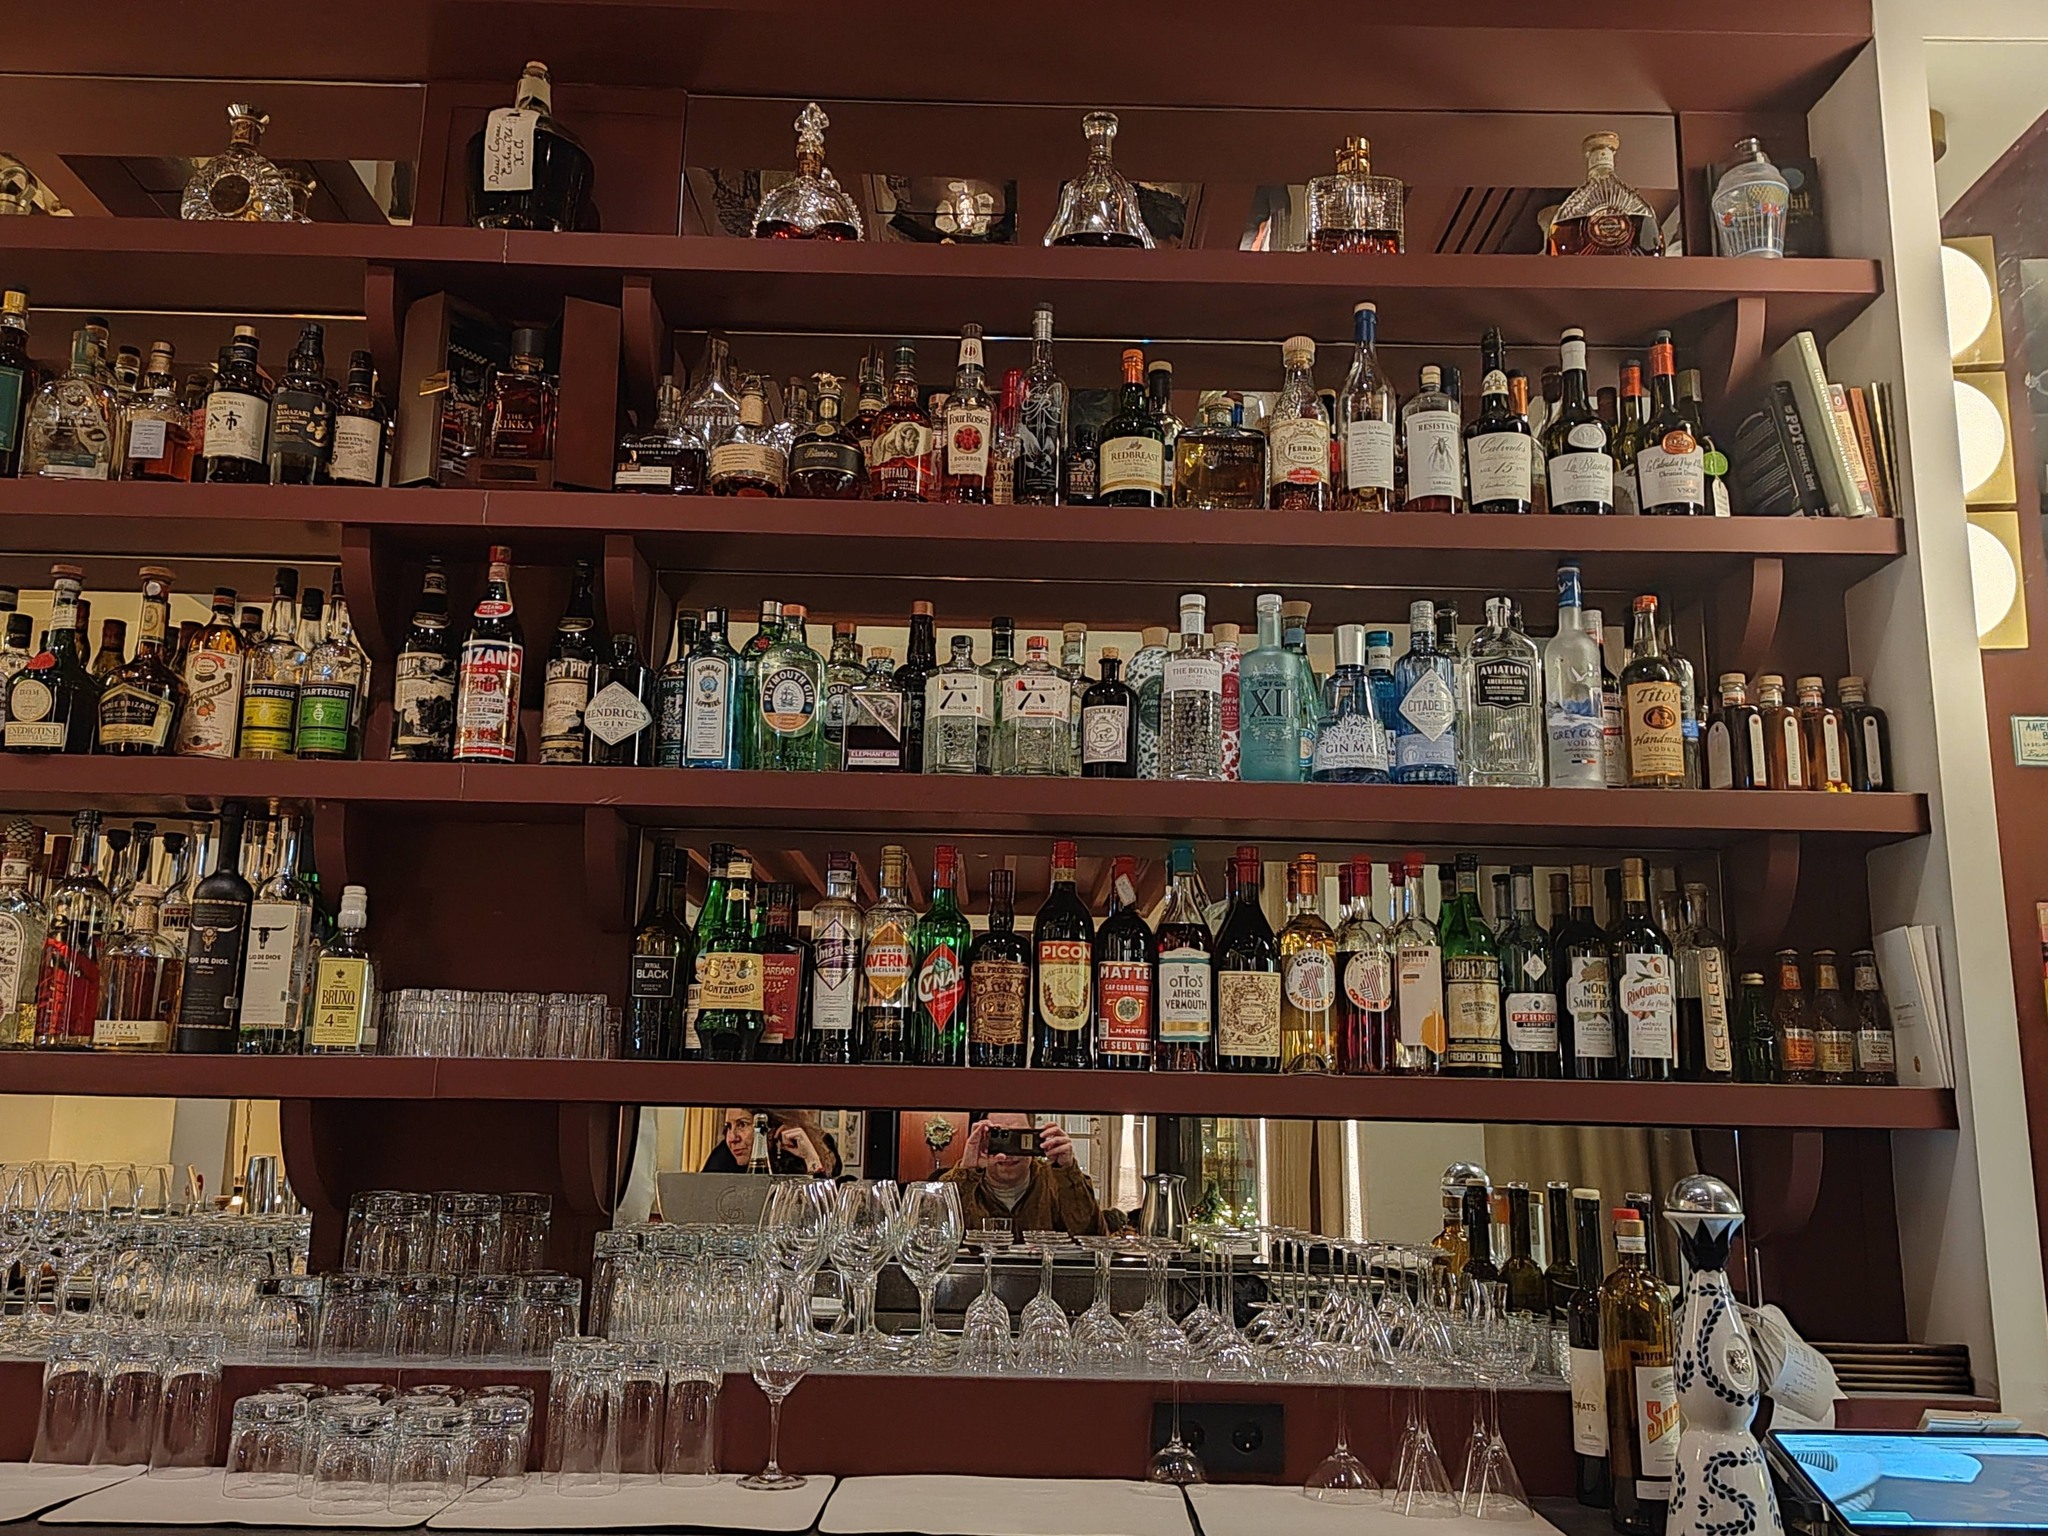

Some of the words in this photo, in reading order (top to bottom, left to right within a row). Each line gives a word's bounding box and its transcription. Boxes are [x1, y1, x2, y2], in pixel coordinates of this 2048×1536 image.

[1288, 443, 1322, 456] FERRAND
[1478, 436, 1526, 454] Calvados
[1110, 451, 1160, 463] REDBREAST
[880, 466, 909, 480] BUFFALO
[461, 647, 519, 668] INZANO
[1172, 667, 1189, 676] THE
[1479, 665, 1530, 678] AVIATION
[763, 670, 808, 701] PLYMOUTH
[802, 681, 815, 703] GIN
[1635, 686, 1678, 704] Tito's
[587, 707, 648, 721] HENDRICK'S
[603, 720, 624, 728] GIN
[1552, 730, 1577, 744] GREY
[1579, 727, 1603, 742] GOO
[1633, 732, 1682, 747] Handma
[1325, 740, 1351, 754] GIN
[1646, 747, 1677, 756] VODKA
[850, 753, 883, 762] ELEPHANT
[884, 753, 899, 762] GIN
[1041, 945, 1092, 959] PICON
[1401, 950, 1430, 958] BITTER
[865, 954, 913, 968] AVERNA
[636, 969, 669, 980] BLACK
[763, 967, 796, 976] ARBARO
[973, 966, 986, 974] DEL
[917, 965, 965, 1003] CYNAR
[1169, 974, 1204, 988] OTTO'S
[1704, 950, 1724, 1019] DOUBLE
[703, 982, 755, 995] MONTENEGRO
[1172, 989, 1201, 999] ATHENS
[1583, 983, 1606, 996] NOIX
[322, 990, 356, 1005] BRUXO
[1573, 996, 1597, 1009] SAINT
[1165, 999, 1208, 1010] VERMOUTH
[325, 1013, 335, 1028] 4
[1513, 1013, 1556, 1022] PERNOD
[1110, 1041, 1133, 1051] SEUL
[1573, 1401, 1597, 1412] RATS
